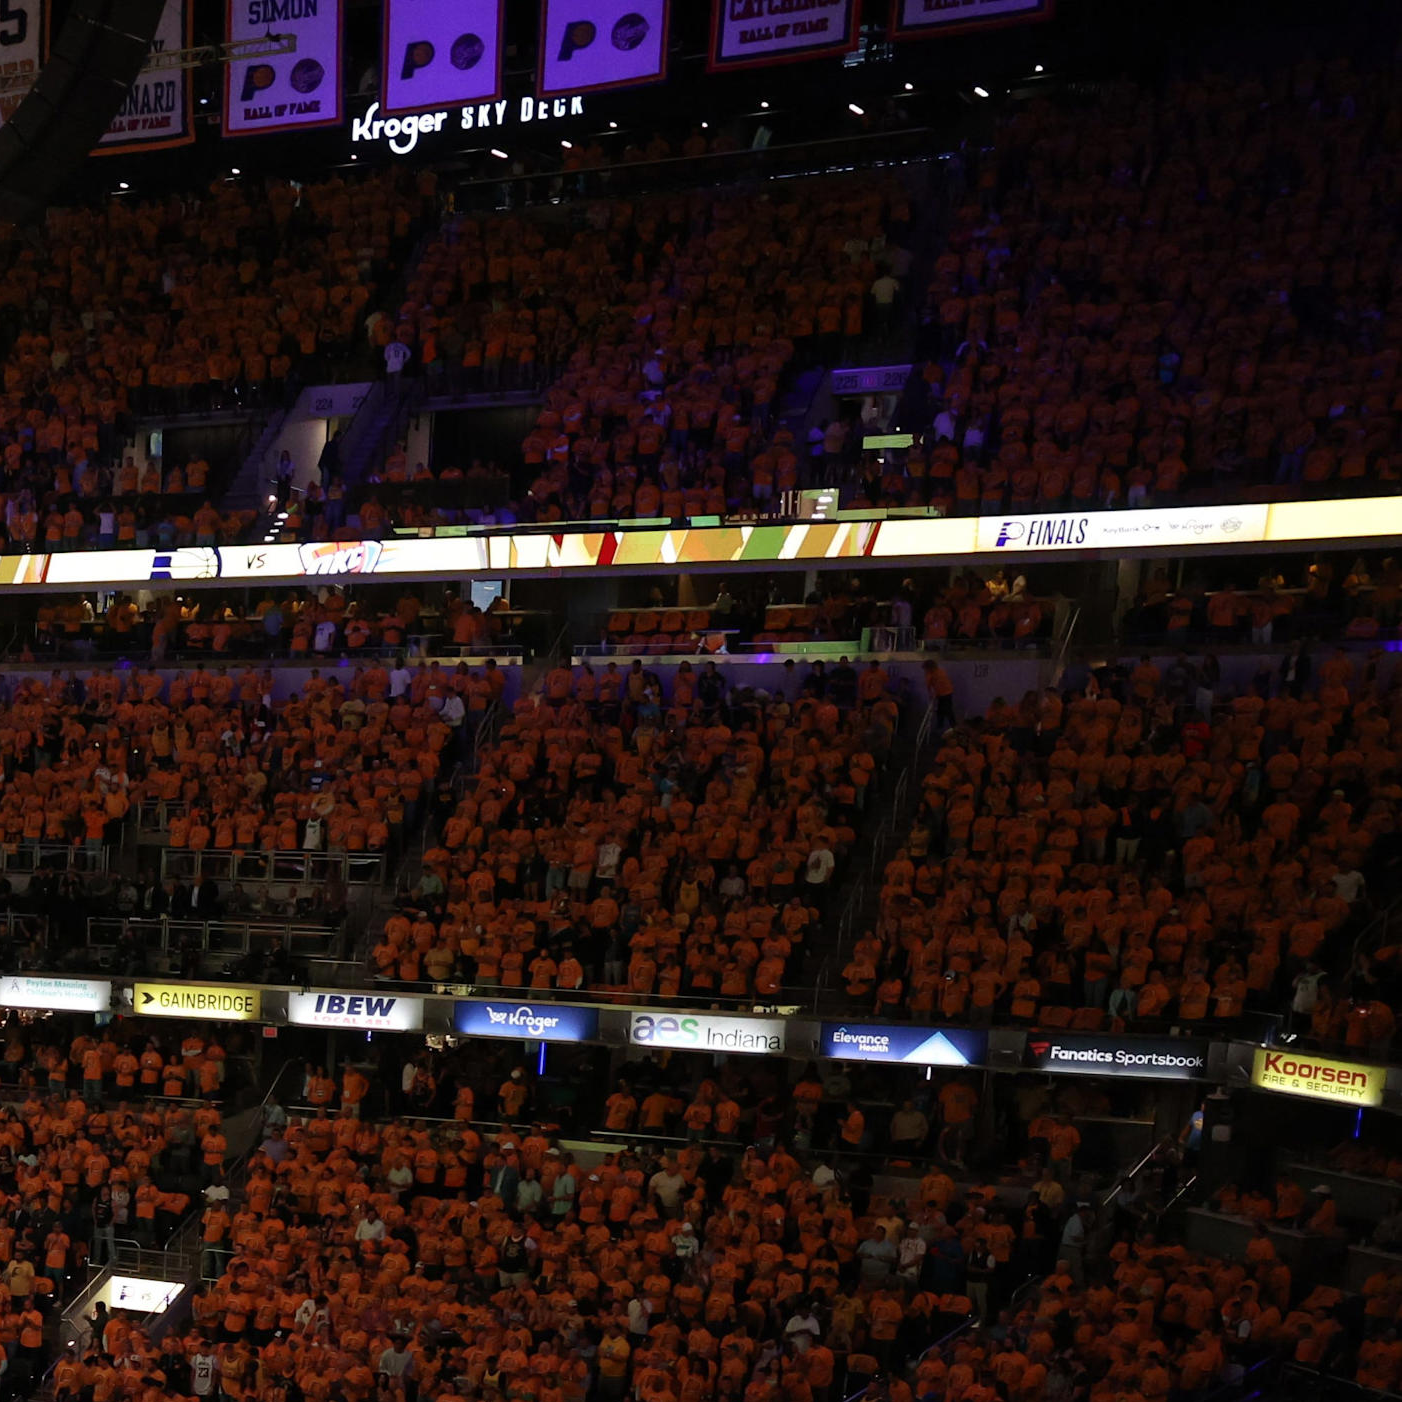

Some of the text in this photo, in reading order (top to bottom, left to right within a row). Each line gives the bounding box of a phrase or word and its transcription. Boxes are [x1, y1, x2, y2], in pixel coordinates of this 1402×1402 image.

[248, 0, 318, 24] SIMON
[739, 18, 828, 43] HALL OF FAME
[244, 101, 321, 120] HALL OF FAME
[352, 96, 584, 154] Kroger SKY DECK
[1026, 517, 1088, 546] FINALS
[247, 552, 268, 569] VS
[160, 991, 254, 1013] GAINBRIDGE
[314, 995, 396, 1017] IBEW
[509, 1006, 559, 1035] Kroger
[633, 1015, 782, 1050] aes Indiana
[833, 1031, 890, 1046] Elevance
[859, 1043, 889, 1053] Health
[1050, 1046, 1204, 1067] Fanatics Sportsbook
[1265, 1052, 1367, 1088] Koorsen
[1262, 1073, 1366, 1098] FIRE & SECURITY
